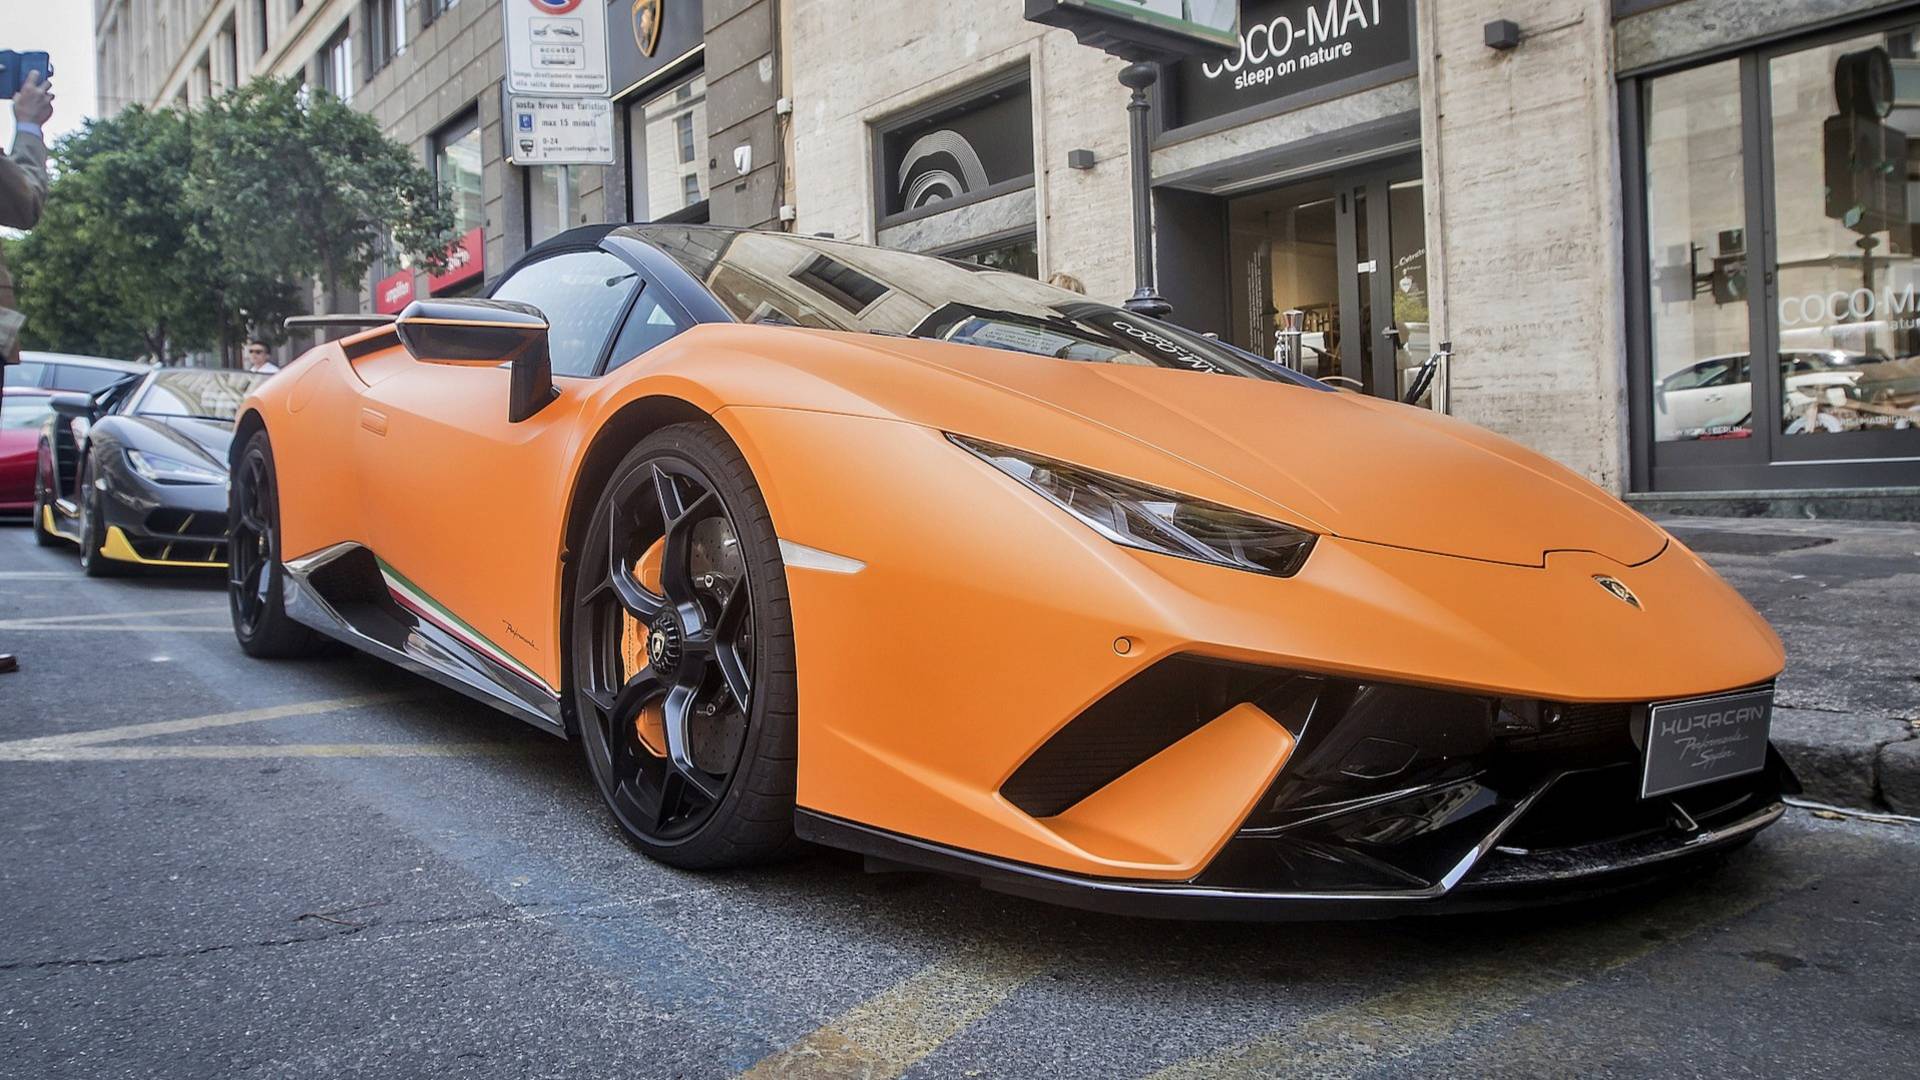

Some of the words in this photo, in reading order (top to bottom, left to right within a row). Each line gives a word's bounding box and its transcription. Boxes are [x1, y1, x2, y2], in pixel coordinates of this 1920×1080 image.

[1234, 66, 1274, 90] sleep
[1277, 59, 1296, 76] on
[1299, 41, 1352, 69] nature
[515, 101, 535, 109] sosta
[560, 119, 569, 127] 15
[572, 119, 597, 127] minuti
[542, 137, 559, 145] 0-24
[1778, 282, 1920, 326] COCO-M
[1661, 705, 1764, 736] HURACAN
